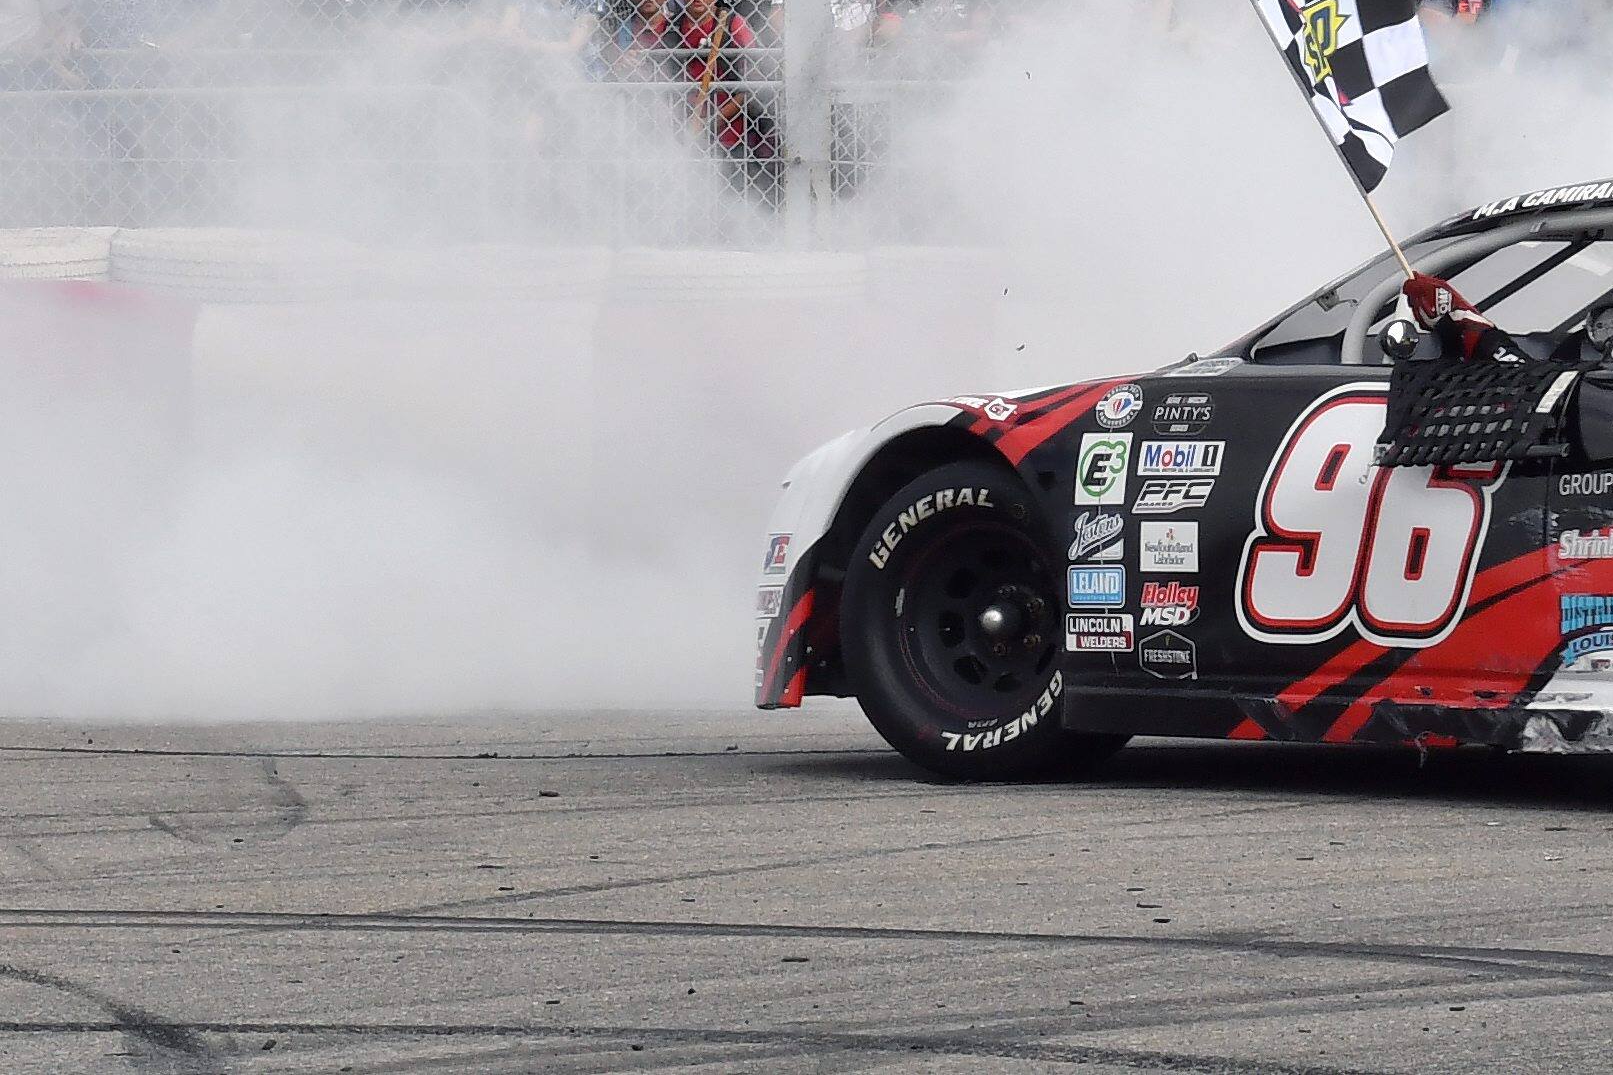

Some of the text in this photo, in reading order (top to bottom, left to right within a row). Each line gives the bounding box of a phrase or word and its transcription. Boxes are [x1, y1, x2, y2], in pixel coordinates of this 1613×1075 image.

[1154, 406, 1212, 420] PINTY'S
[1144, 444, 1197, 467] Mobil
[1140, 481, 1213, 501] PFC
[1235, 381, 1510, 648] 96
[869, 487, 994, 570] GENERAL
[1072, 572, 1120, 594] LELAND
[1140, 581, 1200, 610] Holley
[1069, 617, 1121, 633] LINCOLN
[1140, 607, 1191, 626] MSD
[1080, 636, 1127, 649] WELDERS
[941, 669, 1063, 752] GENERAL
